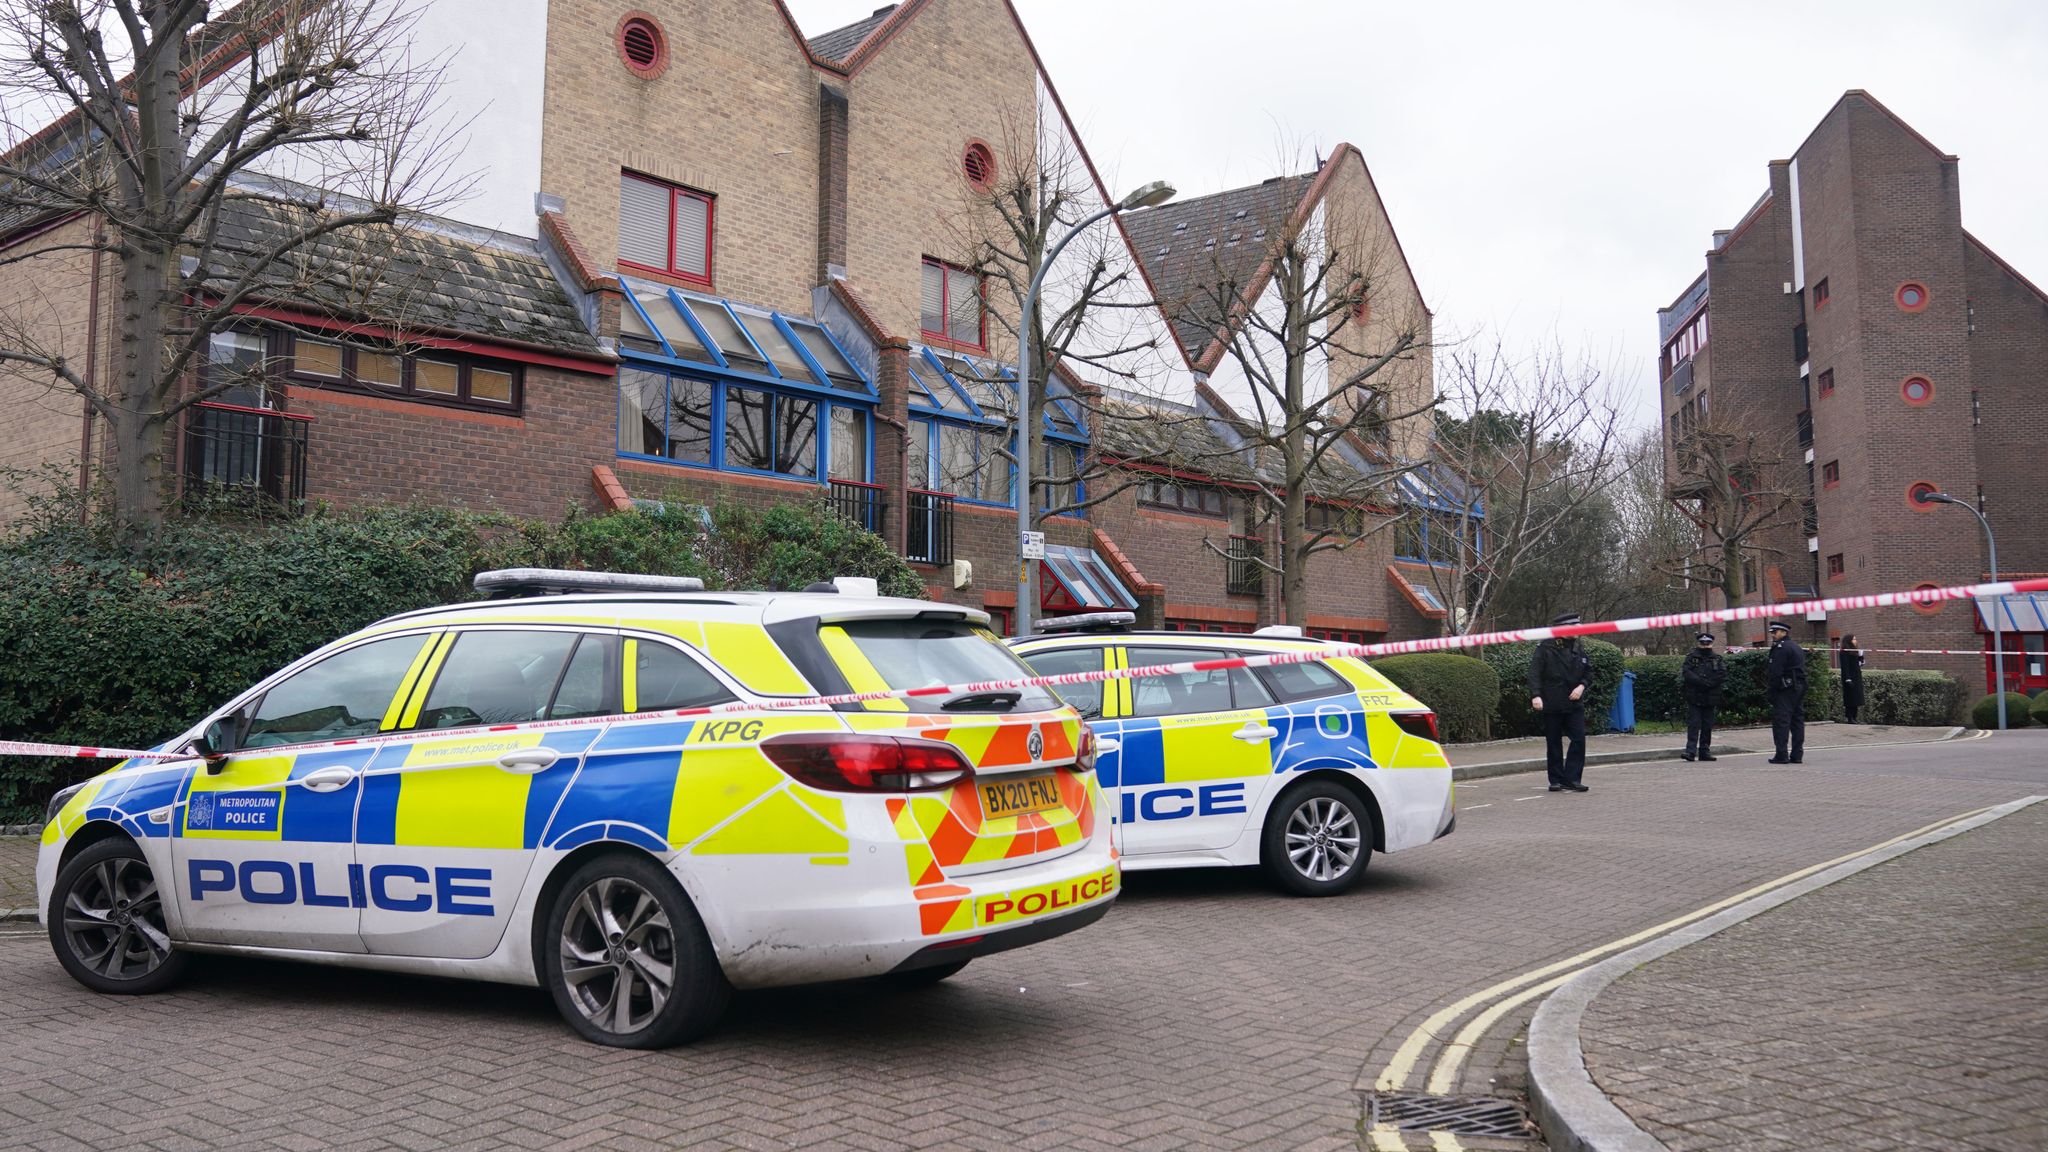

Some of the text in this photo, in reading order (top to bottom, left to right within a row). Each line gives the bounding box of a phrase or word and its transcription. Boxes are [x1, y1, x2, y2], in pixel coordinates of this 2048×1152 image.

[1361, 695, 1393, 706] FRZ
[698, 720, 763, 742] KPG
[424, 741, 519, 757] www.met.police.uk
[220, 798, 276, 808] METROPOLITAN
[986, 780, 1058, 813] BX20 FNJ
[1112, 782, 1247, 825] ICE
[225, 812, 266, 824] POLICE
[188, 859, 495, 916] POLICE
[984, 872, 1115, 923] POLICE
